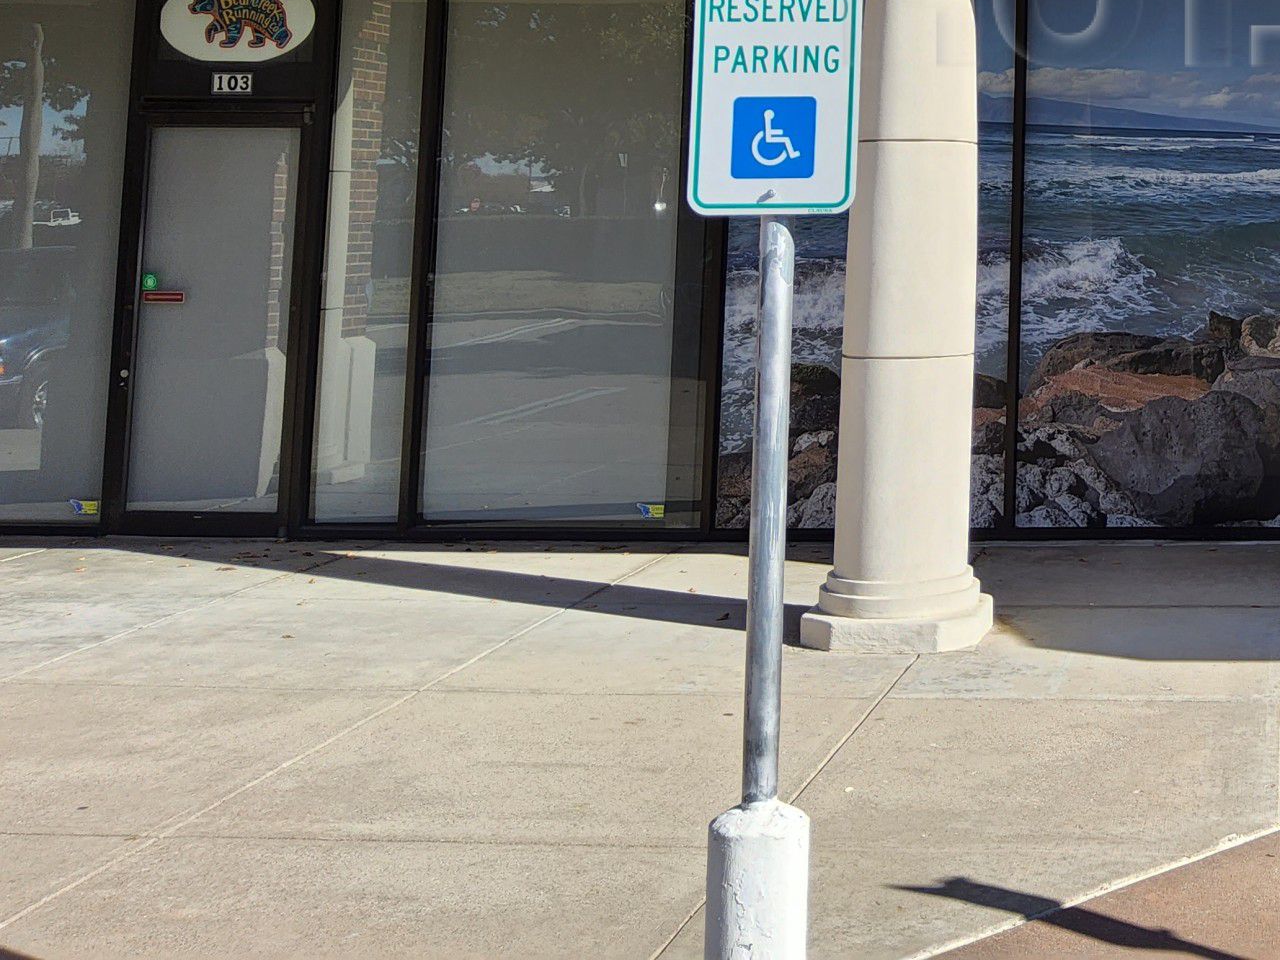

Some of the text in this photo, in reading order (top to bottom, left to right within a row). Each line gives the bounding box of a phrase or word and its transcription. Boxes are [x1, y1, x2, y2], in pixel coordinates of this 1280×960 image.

[222, 8, 272, 29] Running
[713, 45, 841, 74] PARKING
[216, 75, 250, 90] 103
